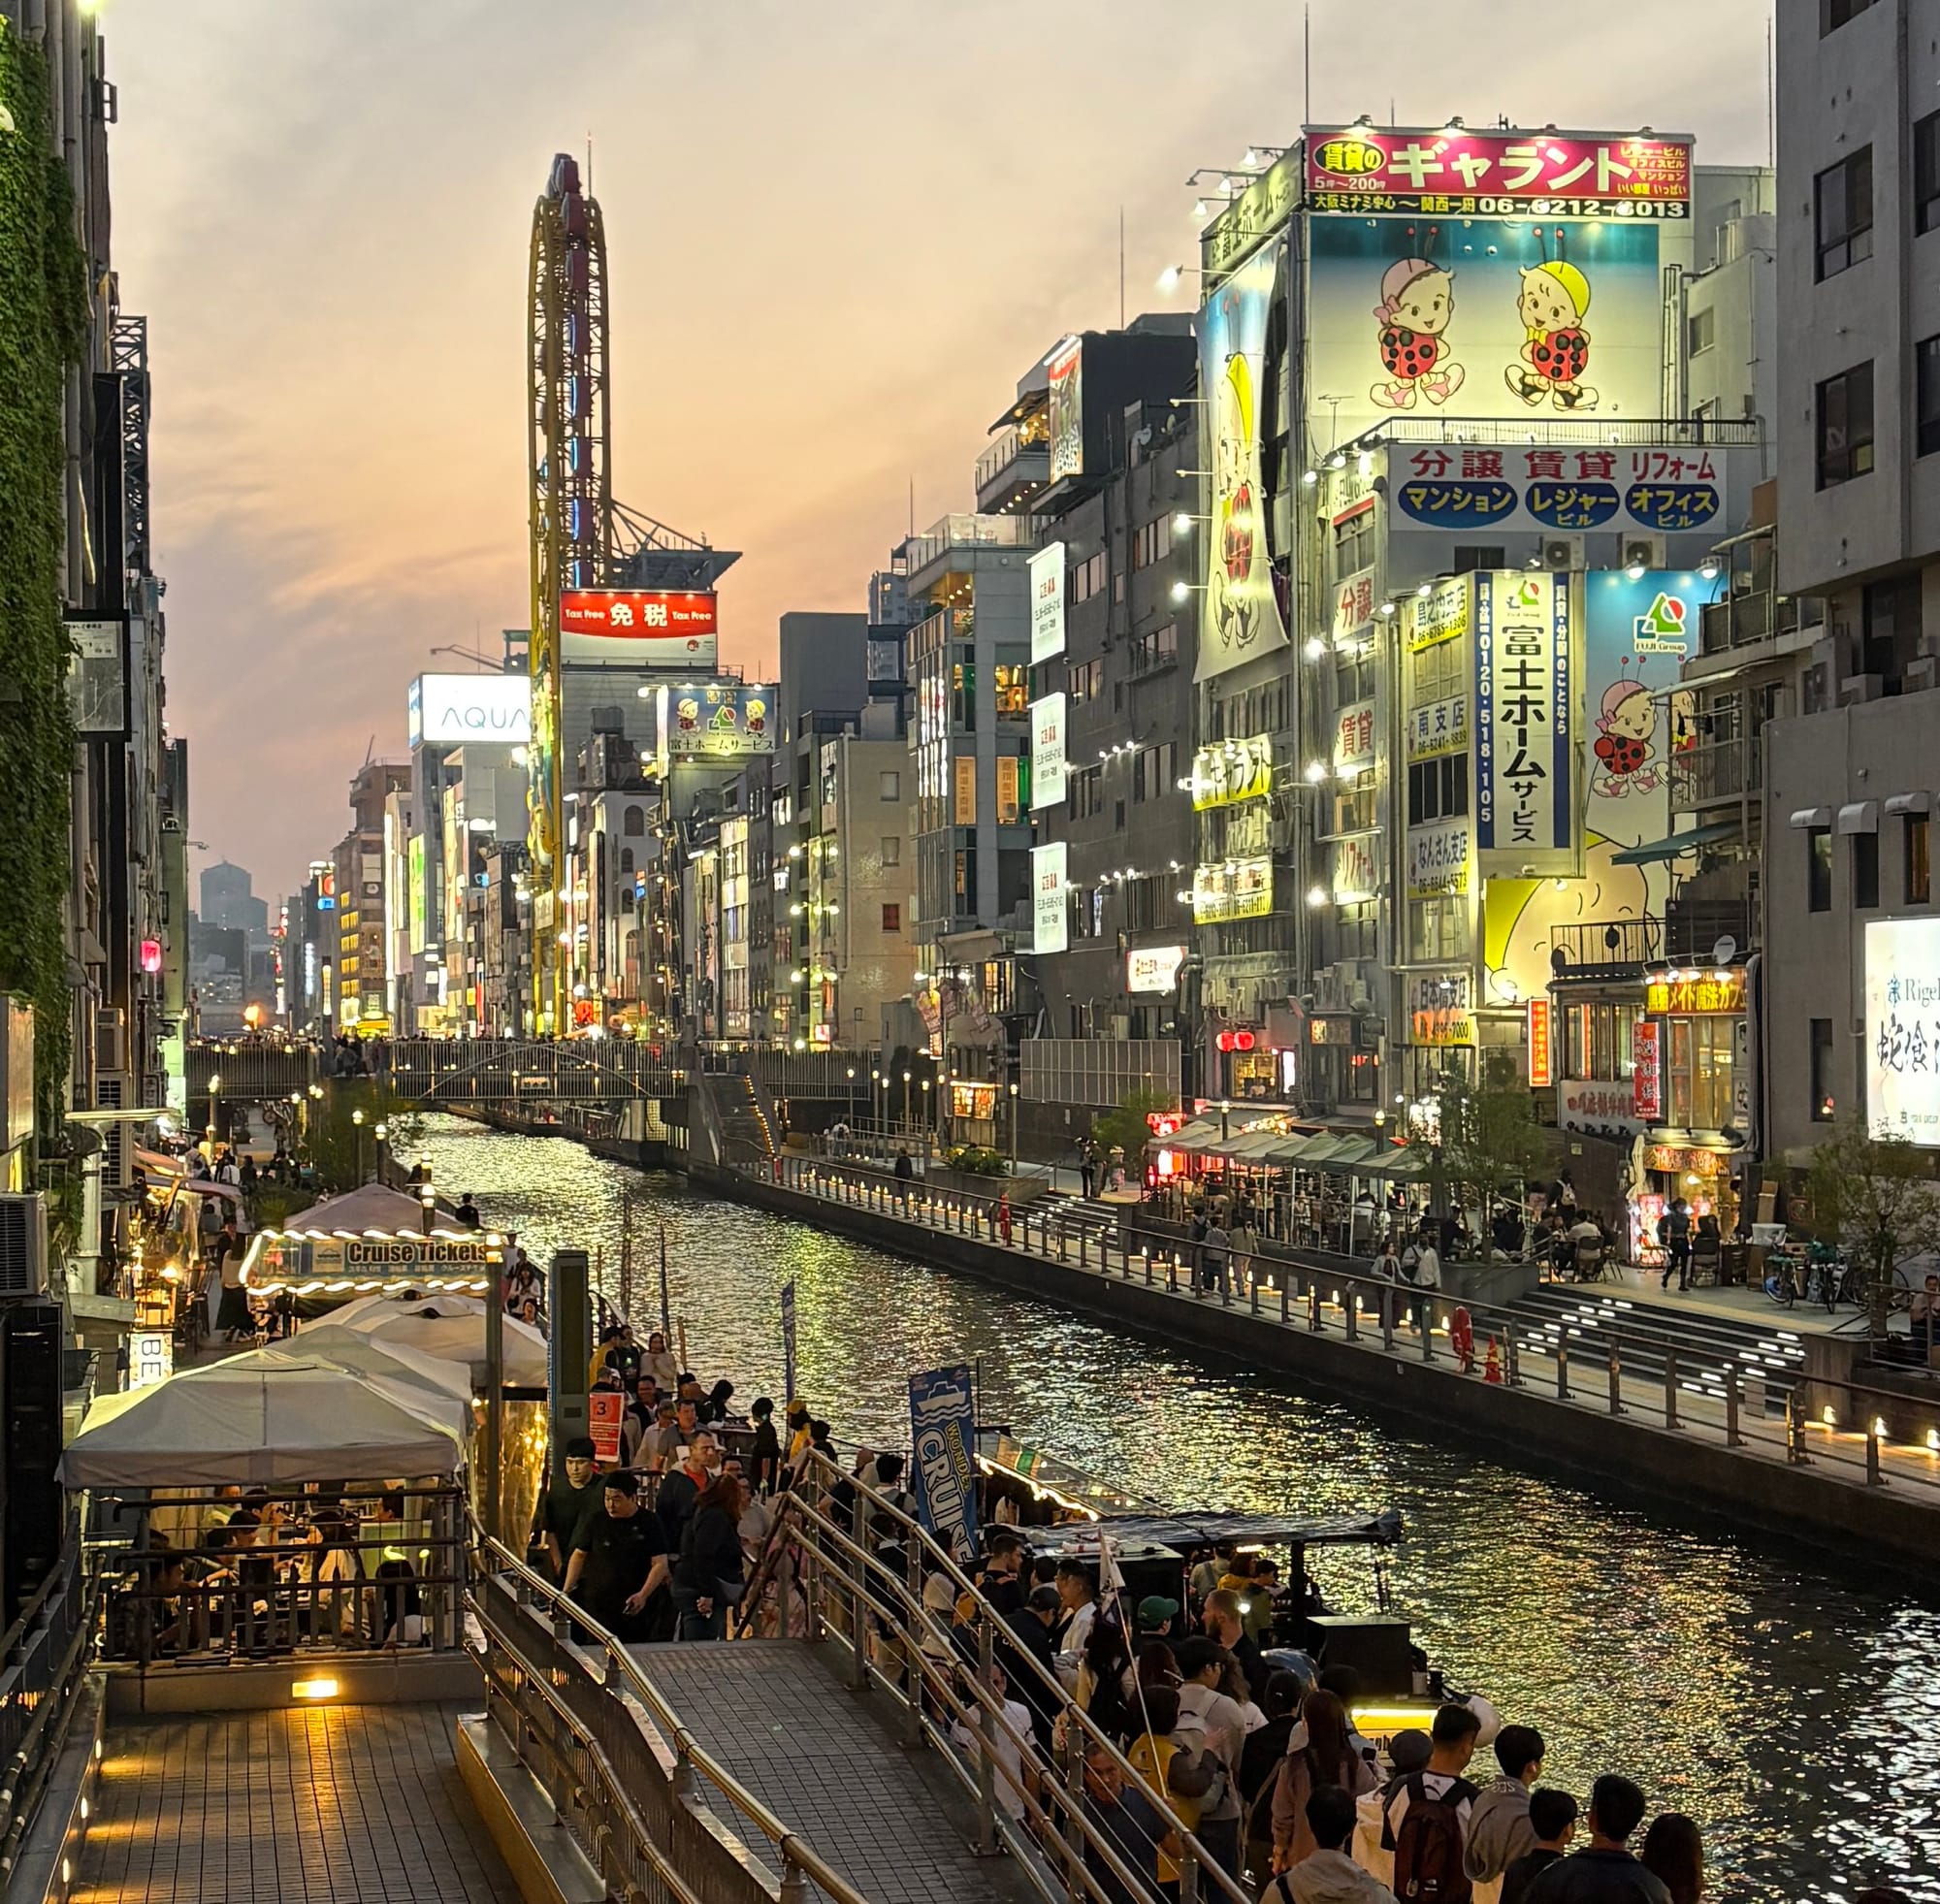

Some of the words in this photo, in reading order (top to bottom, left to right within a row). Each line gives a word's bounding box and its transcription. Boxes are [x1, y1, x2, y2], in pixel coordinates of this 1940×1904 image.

[1323, 143, 1381, 172] 賃貸の
[1388, 140, 1633, 192] ギャラント
[1409, 449, 1504, 479] 分譲
[1524, 450, 1617, 481] 賃貸
[1632, 452, 1717, 482] リフォーム
[1406, 487, 1511, 512] マンション
[1534, 488, 1617, 512] レジャー
[1632, 489, 1715, 513] オフィス
[1557, 514, 1594, 527] ビル
[1657, 514, 1694, 528] ビル
[565, 609, 582, 619] Tax
[584, 609, 605, 619] Free
[610, 602, 667, 627] 免税
[1342, 577, 1372, 629] 分譲
[672, 611, 690, 621] Tax
[692, 611, 712, 621] Free
[1418, 699, 1465, 738] 南支店
[1342, 709, 1373, 757] 賃貸
[1501, 626, 1546, 842] 富士ホームサービス
[347, 1242, 414, 1263] Cruise
[415, 1241, 486, 1263] Tickets
[141, 1339, 162, 1387] BE
[597, 1401, 606, 1416] 3
